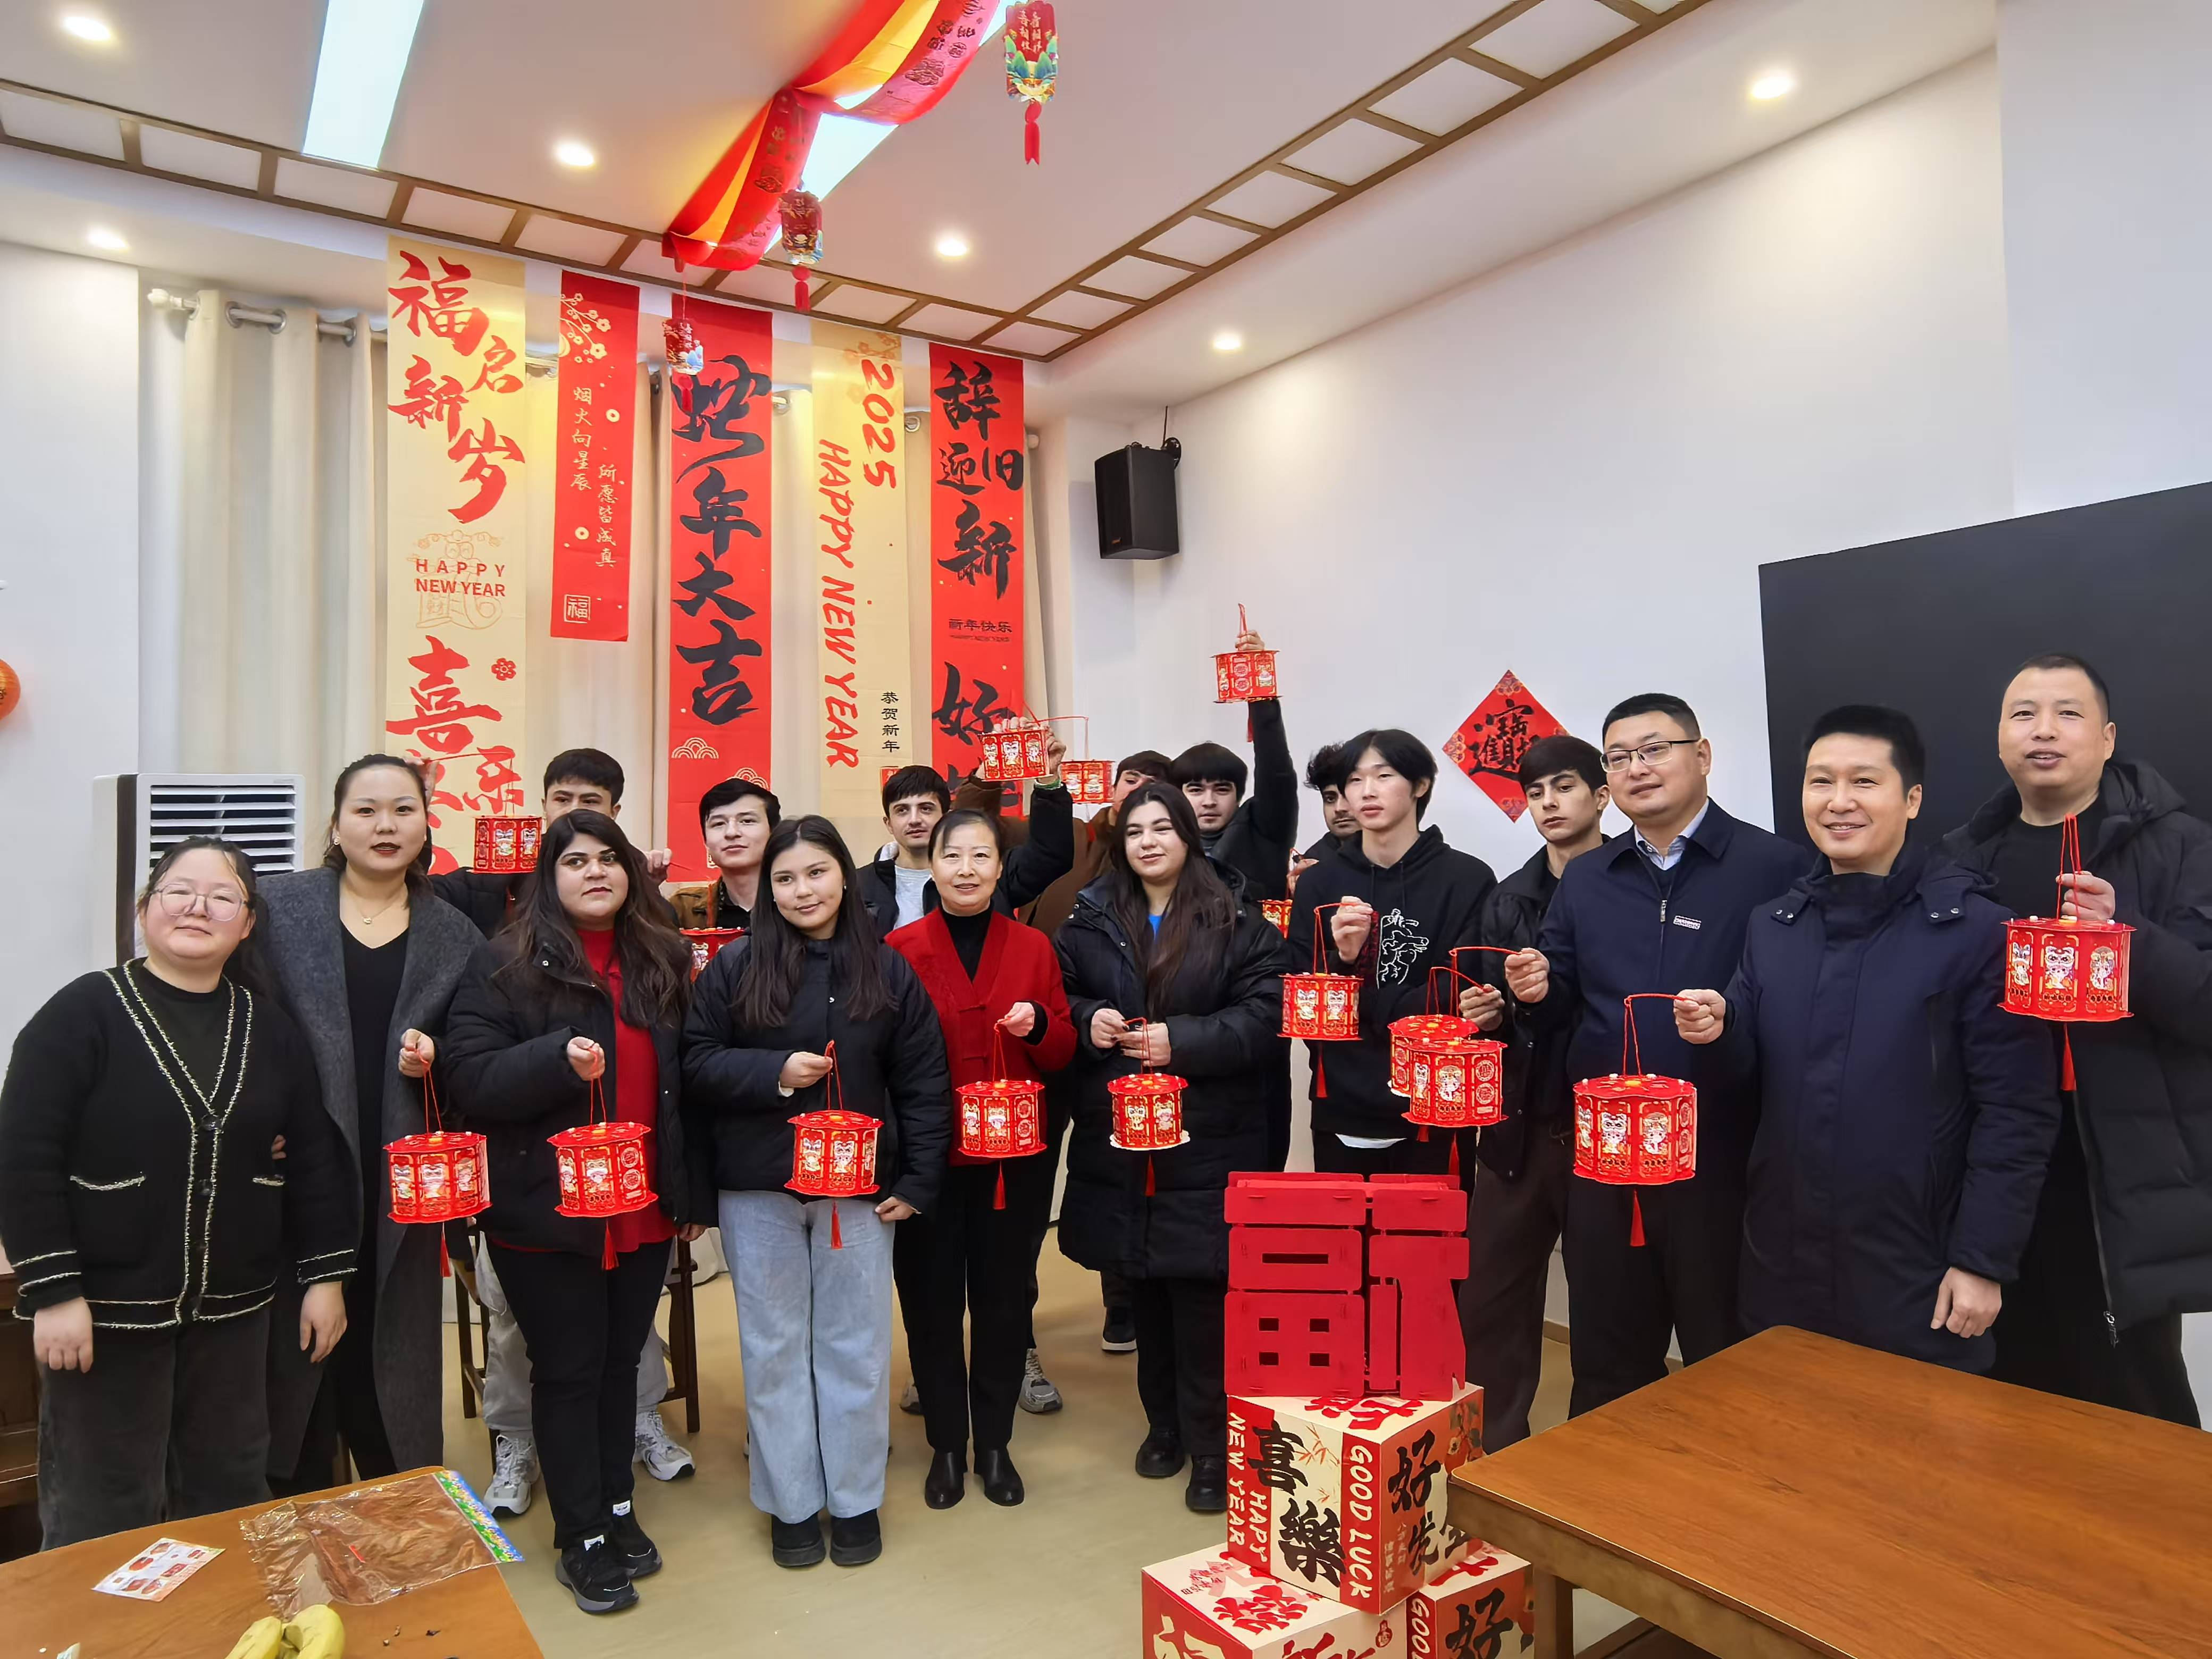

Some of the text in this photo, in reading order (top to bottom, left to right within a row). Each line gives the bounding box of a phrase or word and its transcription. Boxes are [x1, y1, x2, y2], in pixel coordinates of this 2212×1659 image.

[571, 387, 593, 491] 烟火向星辰
[861, 359, 896, 489] 2025
[595, 463, 618, 567] 所愿皆成真
[934, 361, 1023, 600] 辞旧迎新
[416, 558, 505, 577] HAPPY
[416, 578, 506, 597] NEW YEAR
[671, 355, 773, 725] 蛇年大吉
[567, 597, 590, 620] 福
[818, 439, 859, 768] HAPPY NEW YEAR
[881, 691, 900, 752] 恭贺新年
[1228, 1412, 1246, 1546] NEW YEAR
[1348, 1445, 1373, 1599] GOOD LUCK
[1411, 1597, 1430, 1659] GOO
